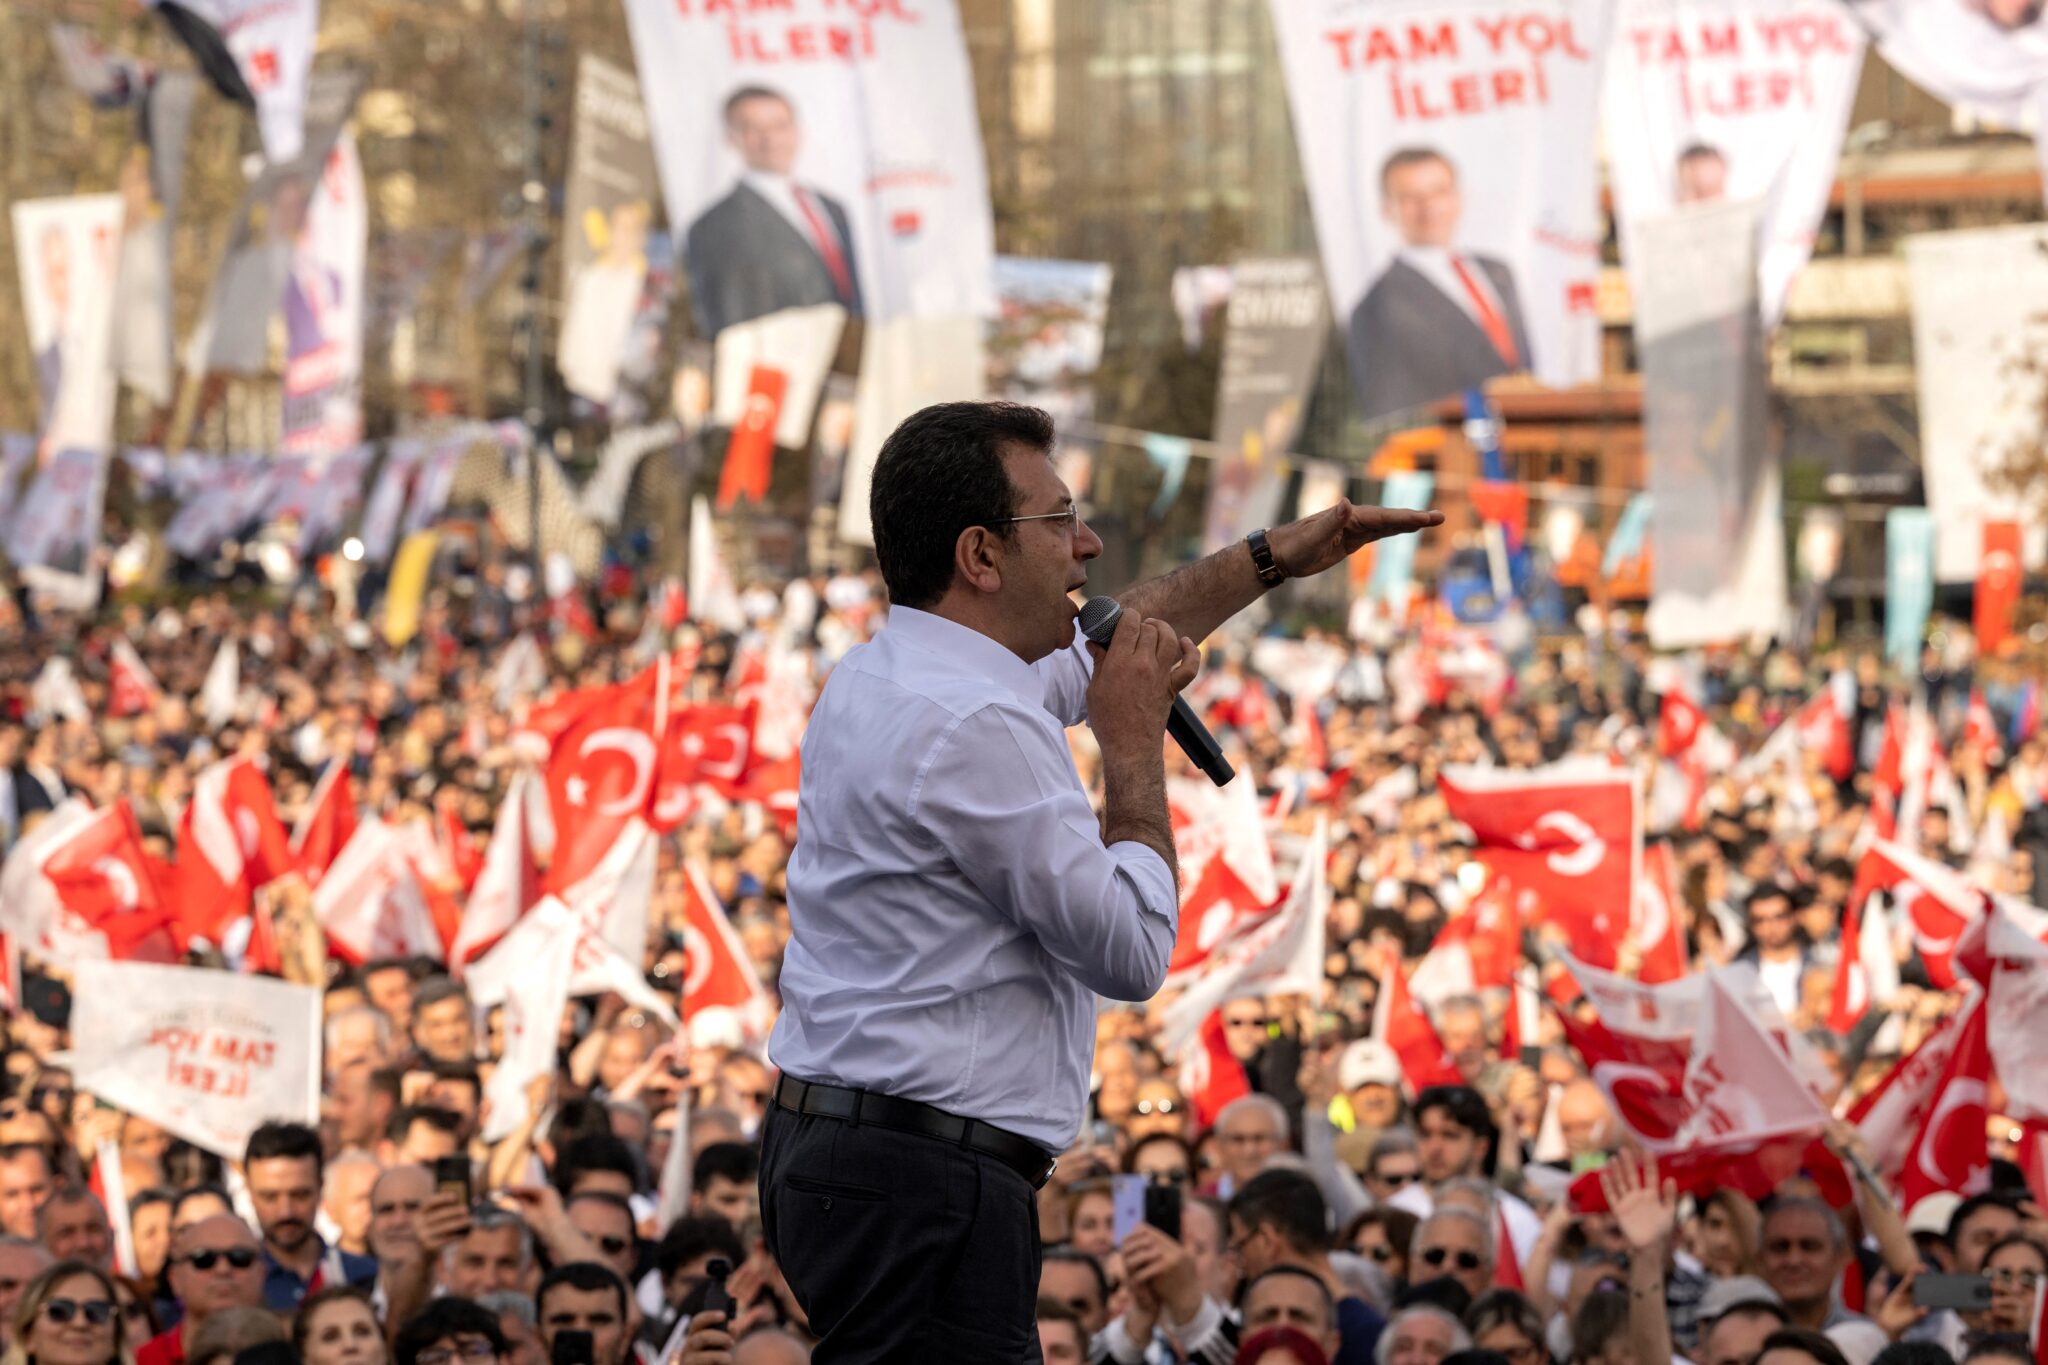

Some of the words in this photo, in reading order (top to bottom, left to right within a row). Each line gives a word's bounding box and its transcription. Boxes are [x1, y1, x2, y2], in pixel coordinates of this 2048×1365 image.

[1324, 22, 1458, 72] TAM
[1473, 13, 1592, 61] YOL
[1630, 21, 1740, 67] TAM
[1754, 14, 1851, 56] YOL
